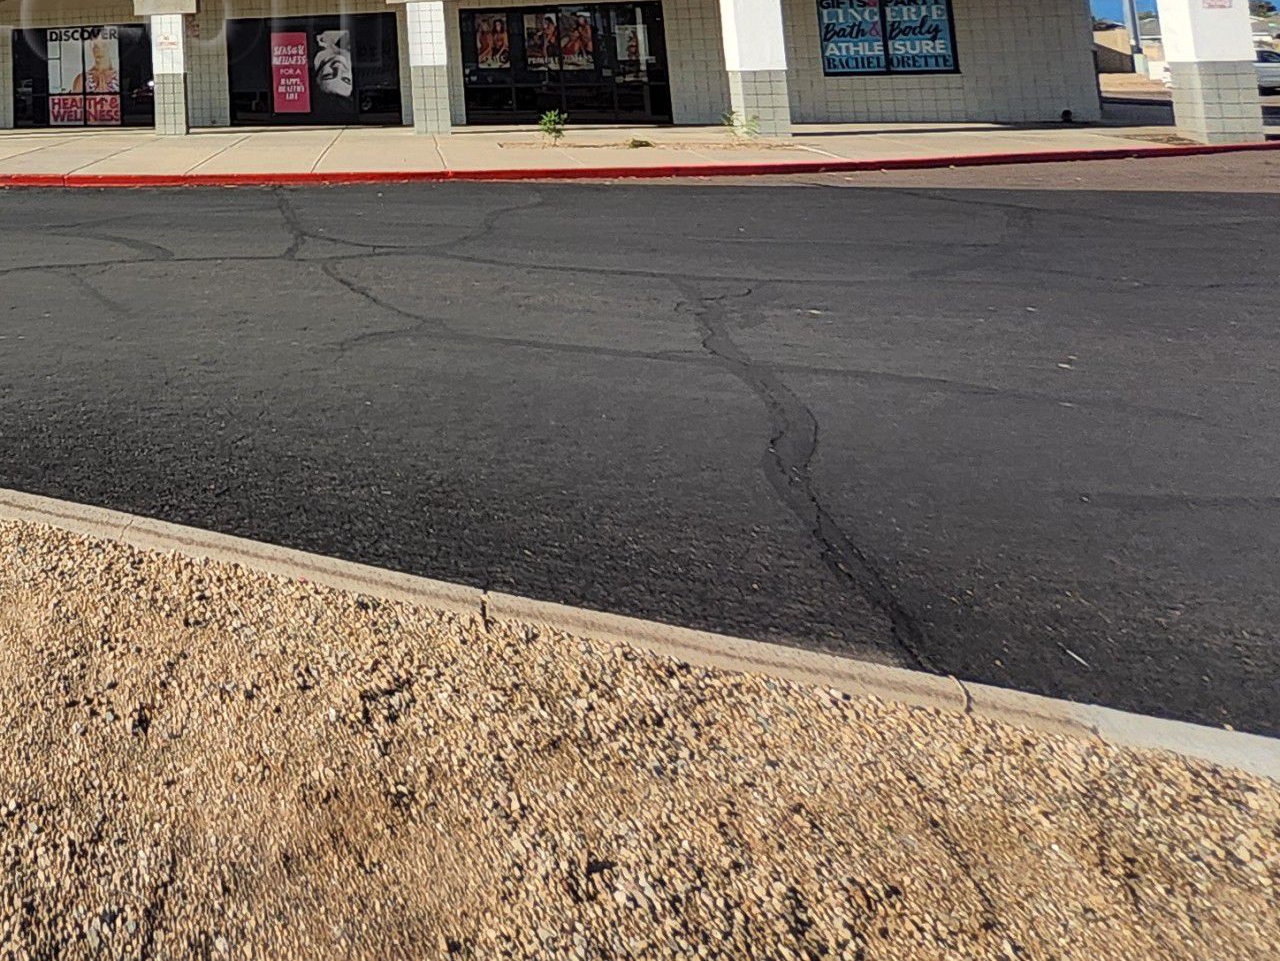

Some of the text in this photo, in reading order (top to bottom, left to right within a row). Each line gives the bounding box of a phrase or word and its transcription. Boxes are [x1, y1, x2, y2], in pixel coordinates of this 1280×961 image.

[823, 5, 945, 23] LINGERIE
[48, 27, 119, 42] DISCOVER
[823, 21, 868, 43] Bath
[889, 14, 942, 42] Body
[825, 39, 947, 56] ATHLEISURE
[827, 53, 953, 70] BACHELORETTE
